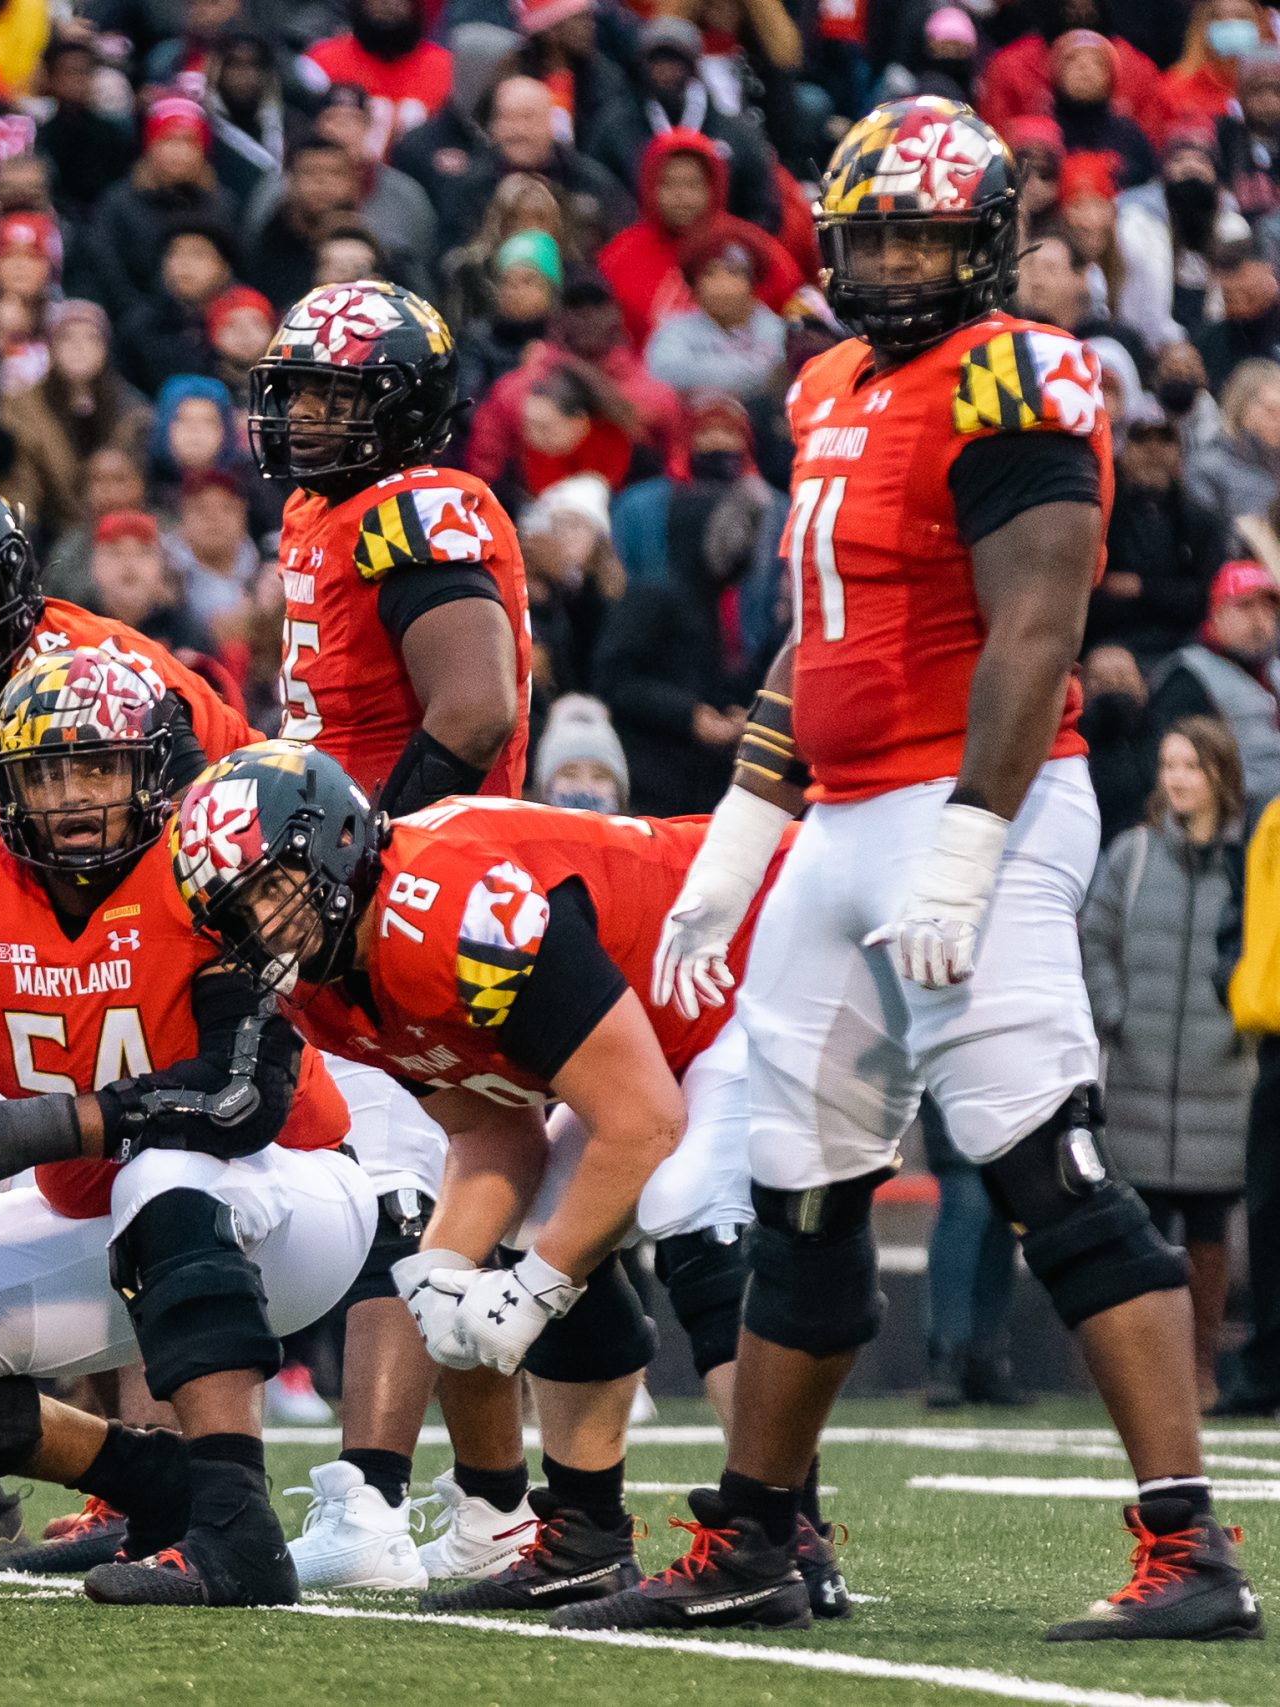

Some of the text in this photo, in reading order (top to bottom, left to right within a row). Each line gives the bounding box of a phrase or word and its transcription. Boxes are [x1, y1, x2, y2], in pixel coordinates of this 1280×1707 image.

[805, 426, 869, 461] YLAND
[792, 476, 848, 643] 71
[278, 617, 324, 741] 5
[380, 871, 441, 944] 78
[13, 959, 131, 997] MARYLAND
[2, 1004, 154, 1099] 54
[530, 1562, 621, 1596] UNDER ARMOUR
[687, 1599, 734, 1615] UNDER
